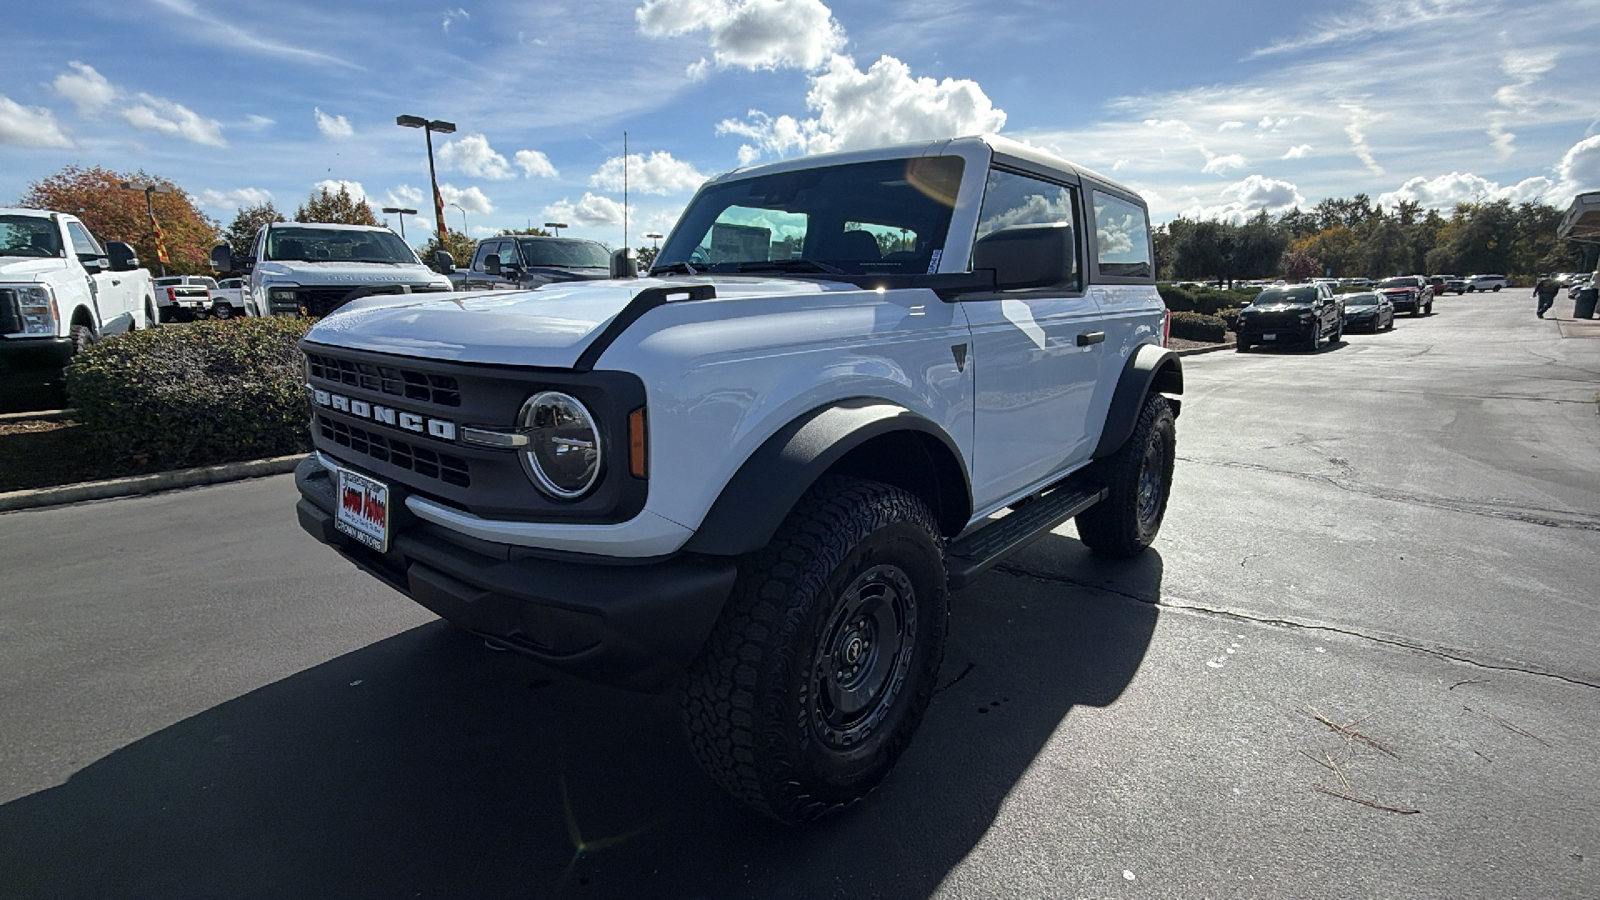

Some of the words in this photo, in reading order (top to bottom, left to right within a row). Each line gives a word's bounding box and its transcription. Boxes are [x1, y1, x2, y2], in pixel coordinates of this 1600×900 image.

[314, 389, 456, 441] BRONCO
[337, 520, 357, 539] CROWN
[357, 530, 381, 550] MOTORS
